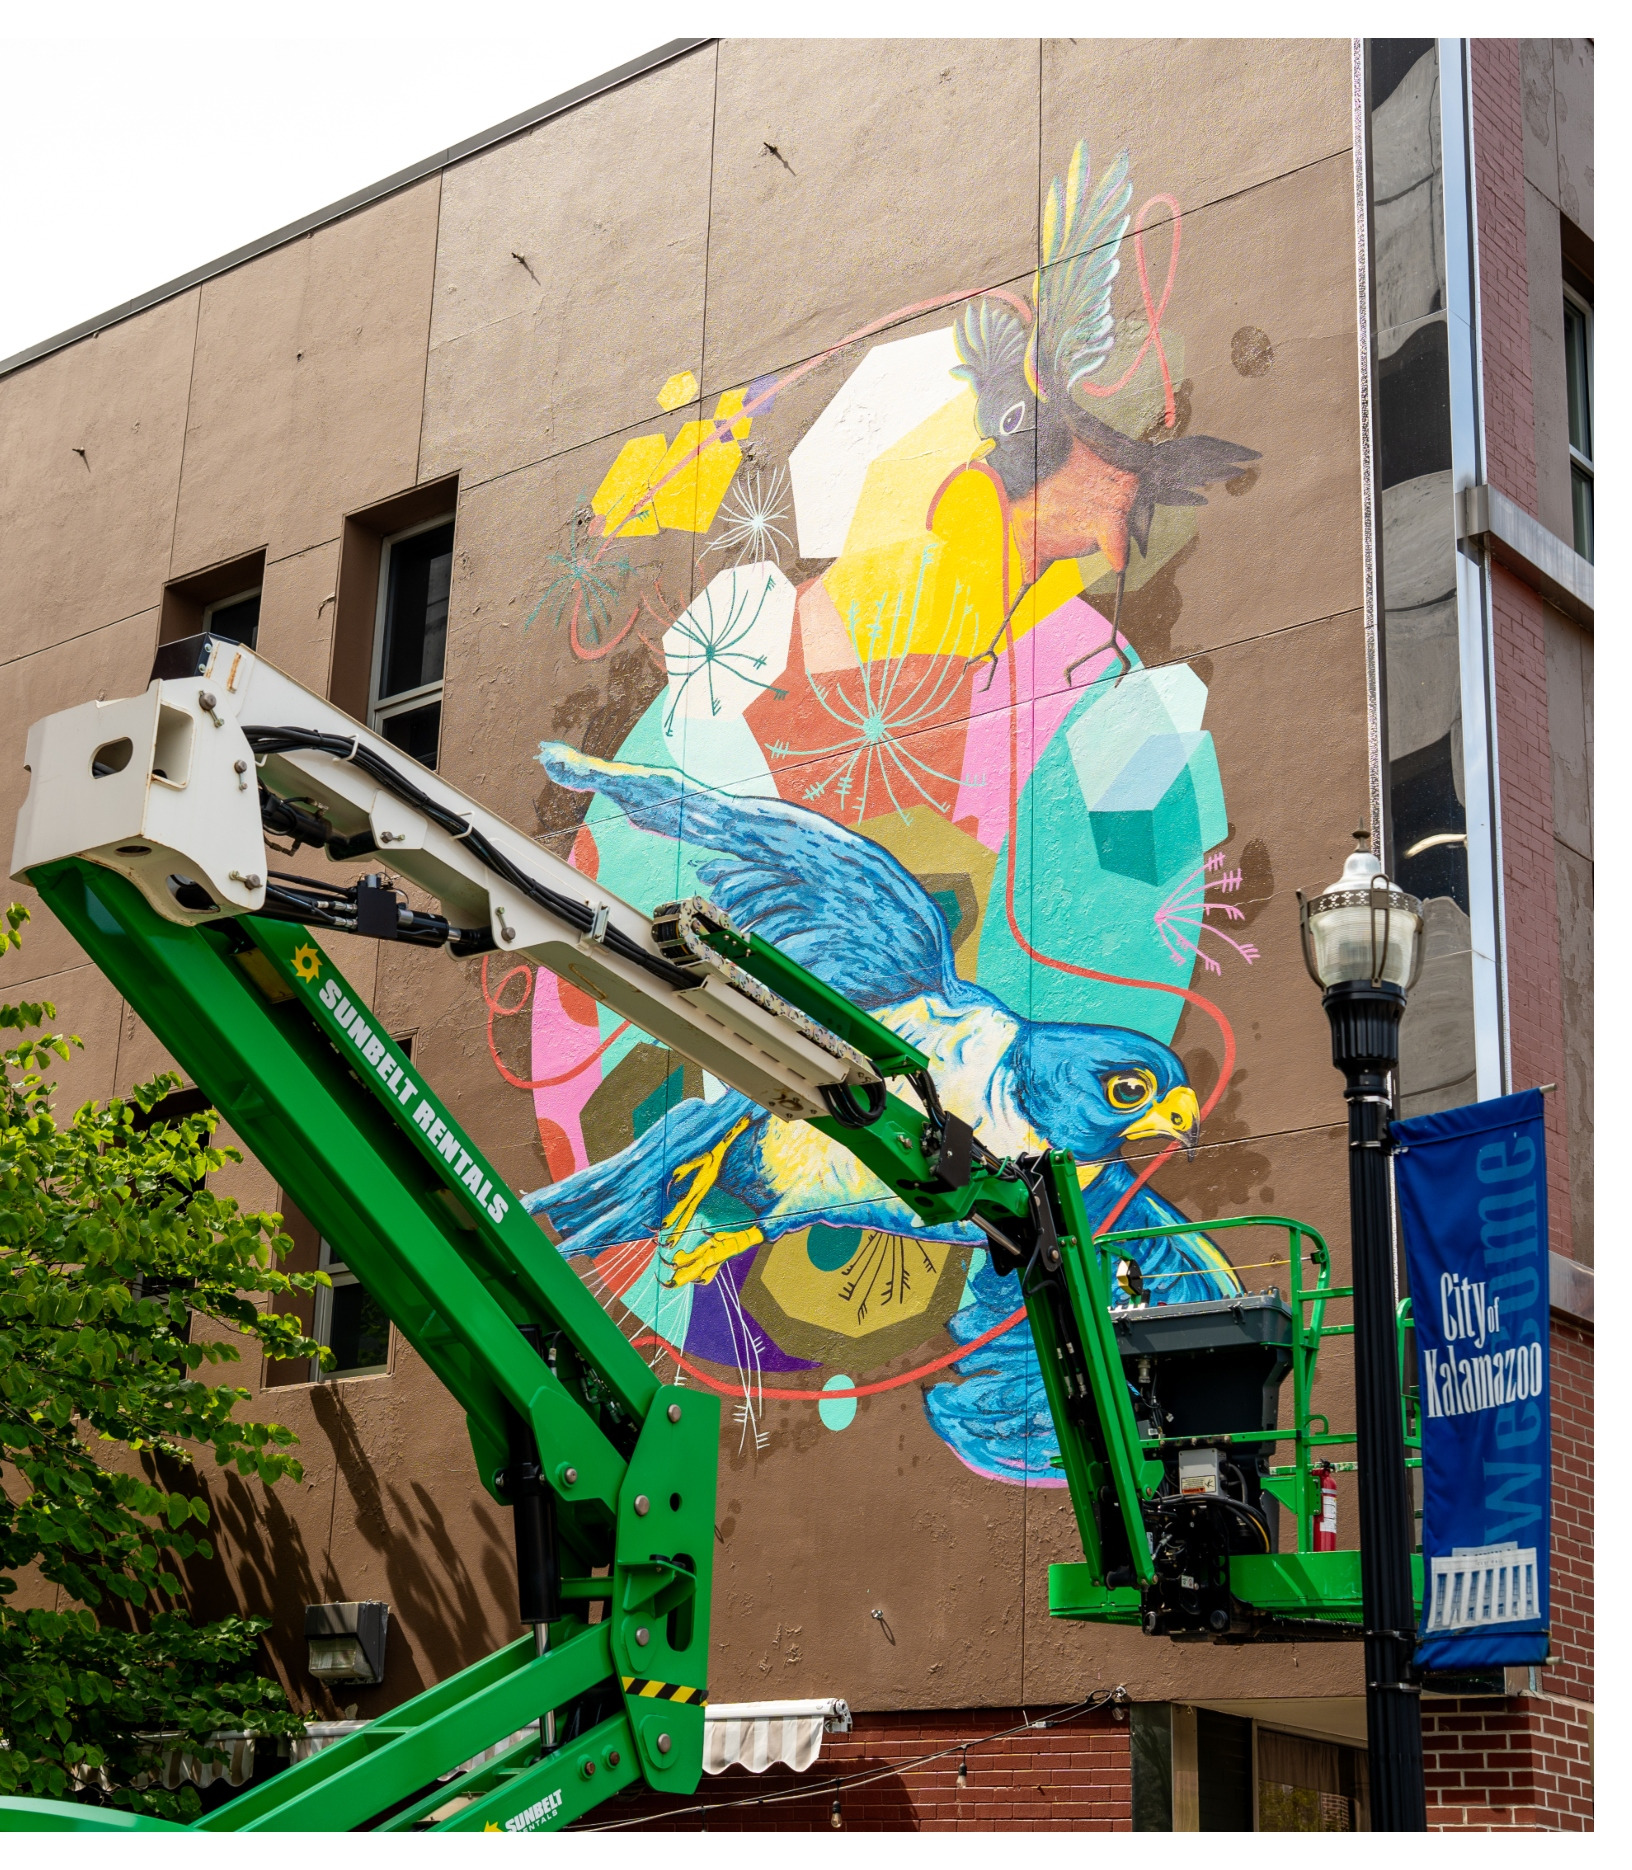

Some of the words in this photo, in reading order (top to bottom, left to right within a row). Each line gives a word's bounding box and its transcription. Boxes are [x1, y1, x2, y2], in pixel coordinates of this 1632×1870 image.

[319, 979, 418, 1105] SUNBELT
[412, 1099, 508, 1223] RENTALS
[1440, 1272, 1486, 1348] City
[1487, 1297, 1500, 1333] of
[1424, 1342, 1542, 1418] Kalamazoo
[505, 1789, 562, 1832] SUNBELT
